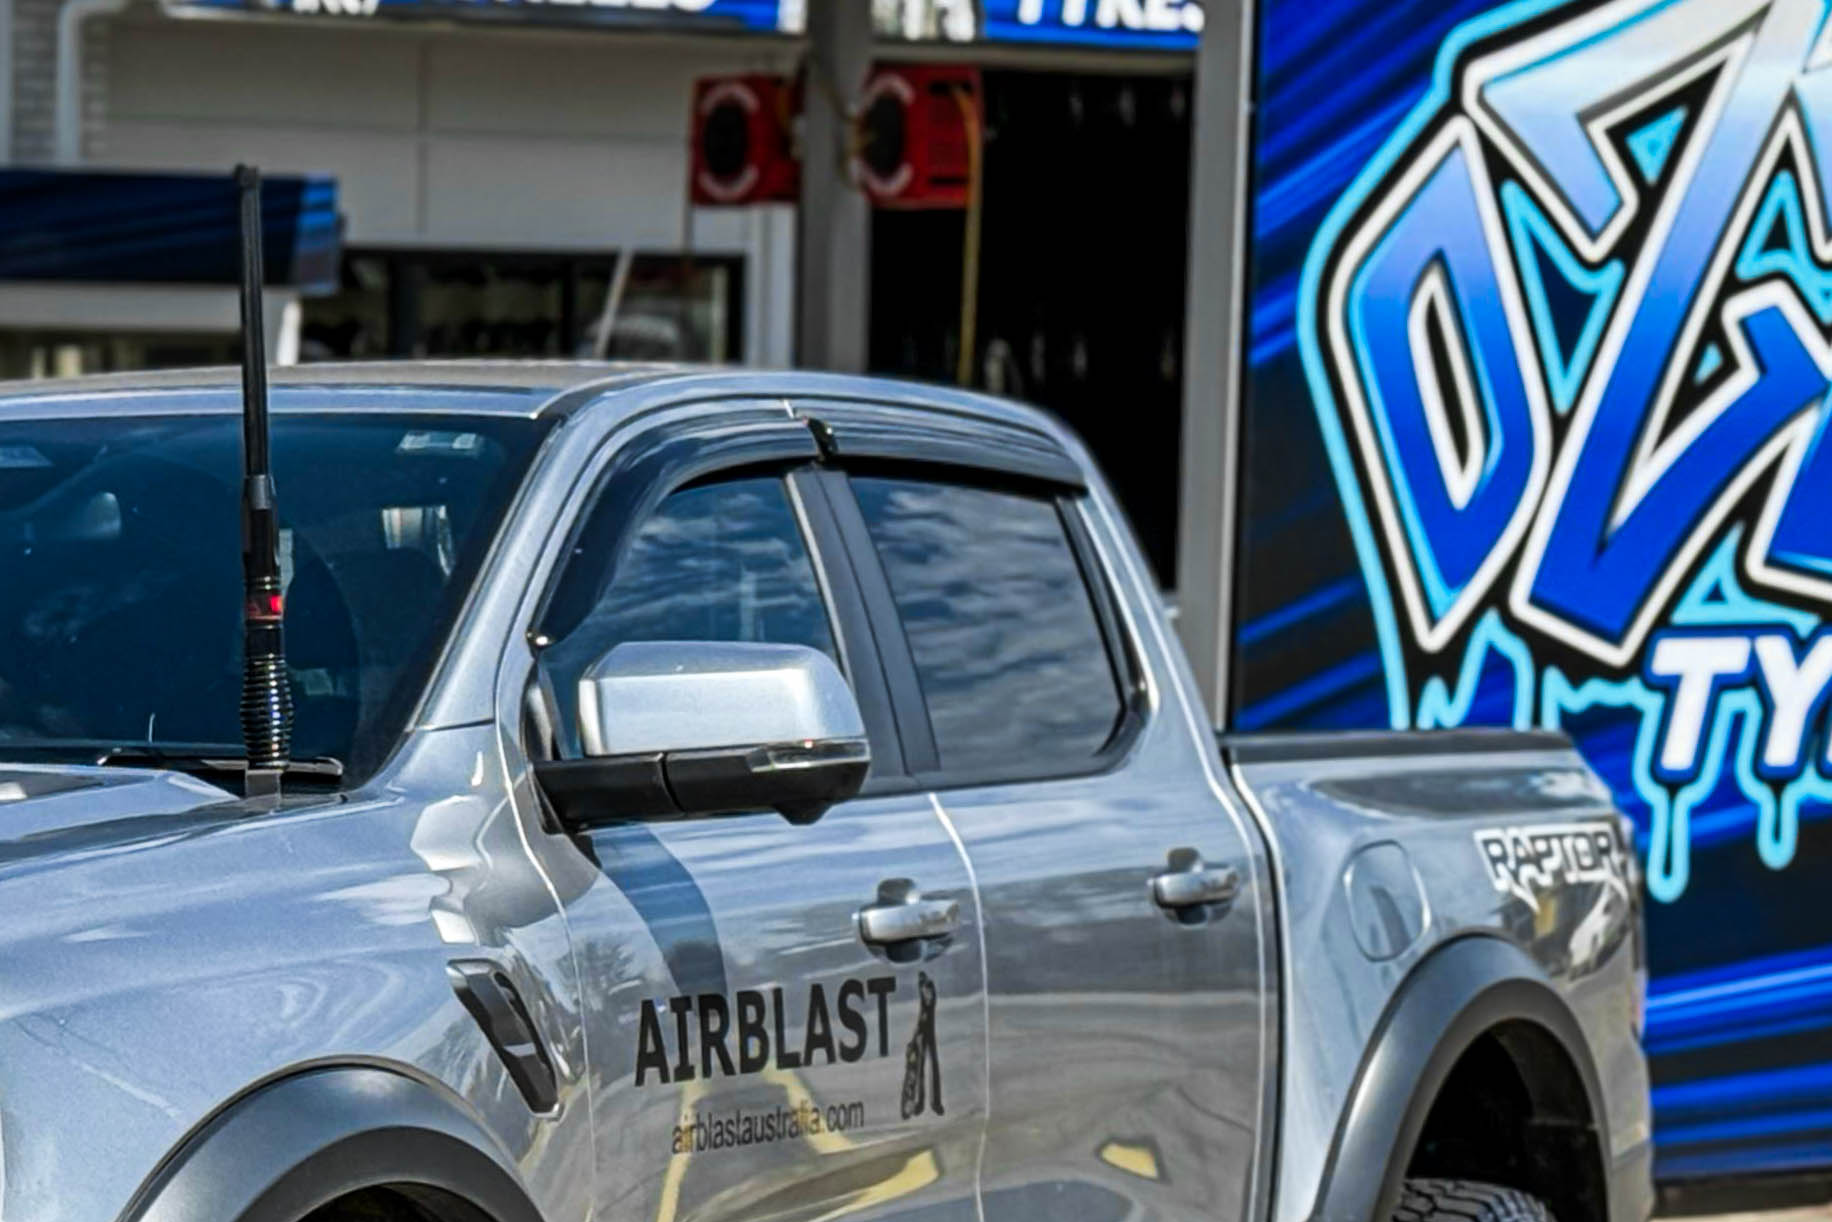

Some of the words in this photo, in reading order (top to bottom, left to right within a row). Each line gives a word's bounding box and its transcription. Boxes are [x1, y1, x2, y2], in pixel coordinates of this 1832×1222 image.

[1650, 636, 1832, 771] TY
[1473, 822, 1622, 906] RAPTOR
[634, 976, 896, 1087] AIRBLAST
[671, 1099, 865, 1154] airblastaustralia.com
